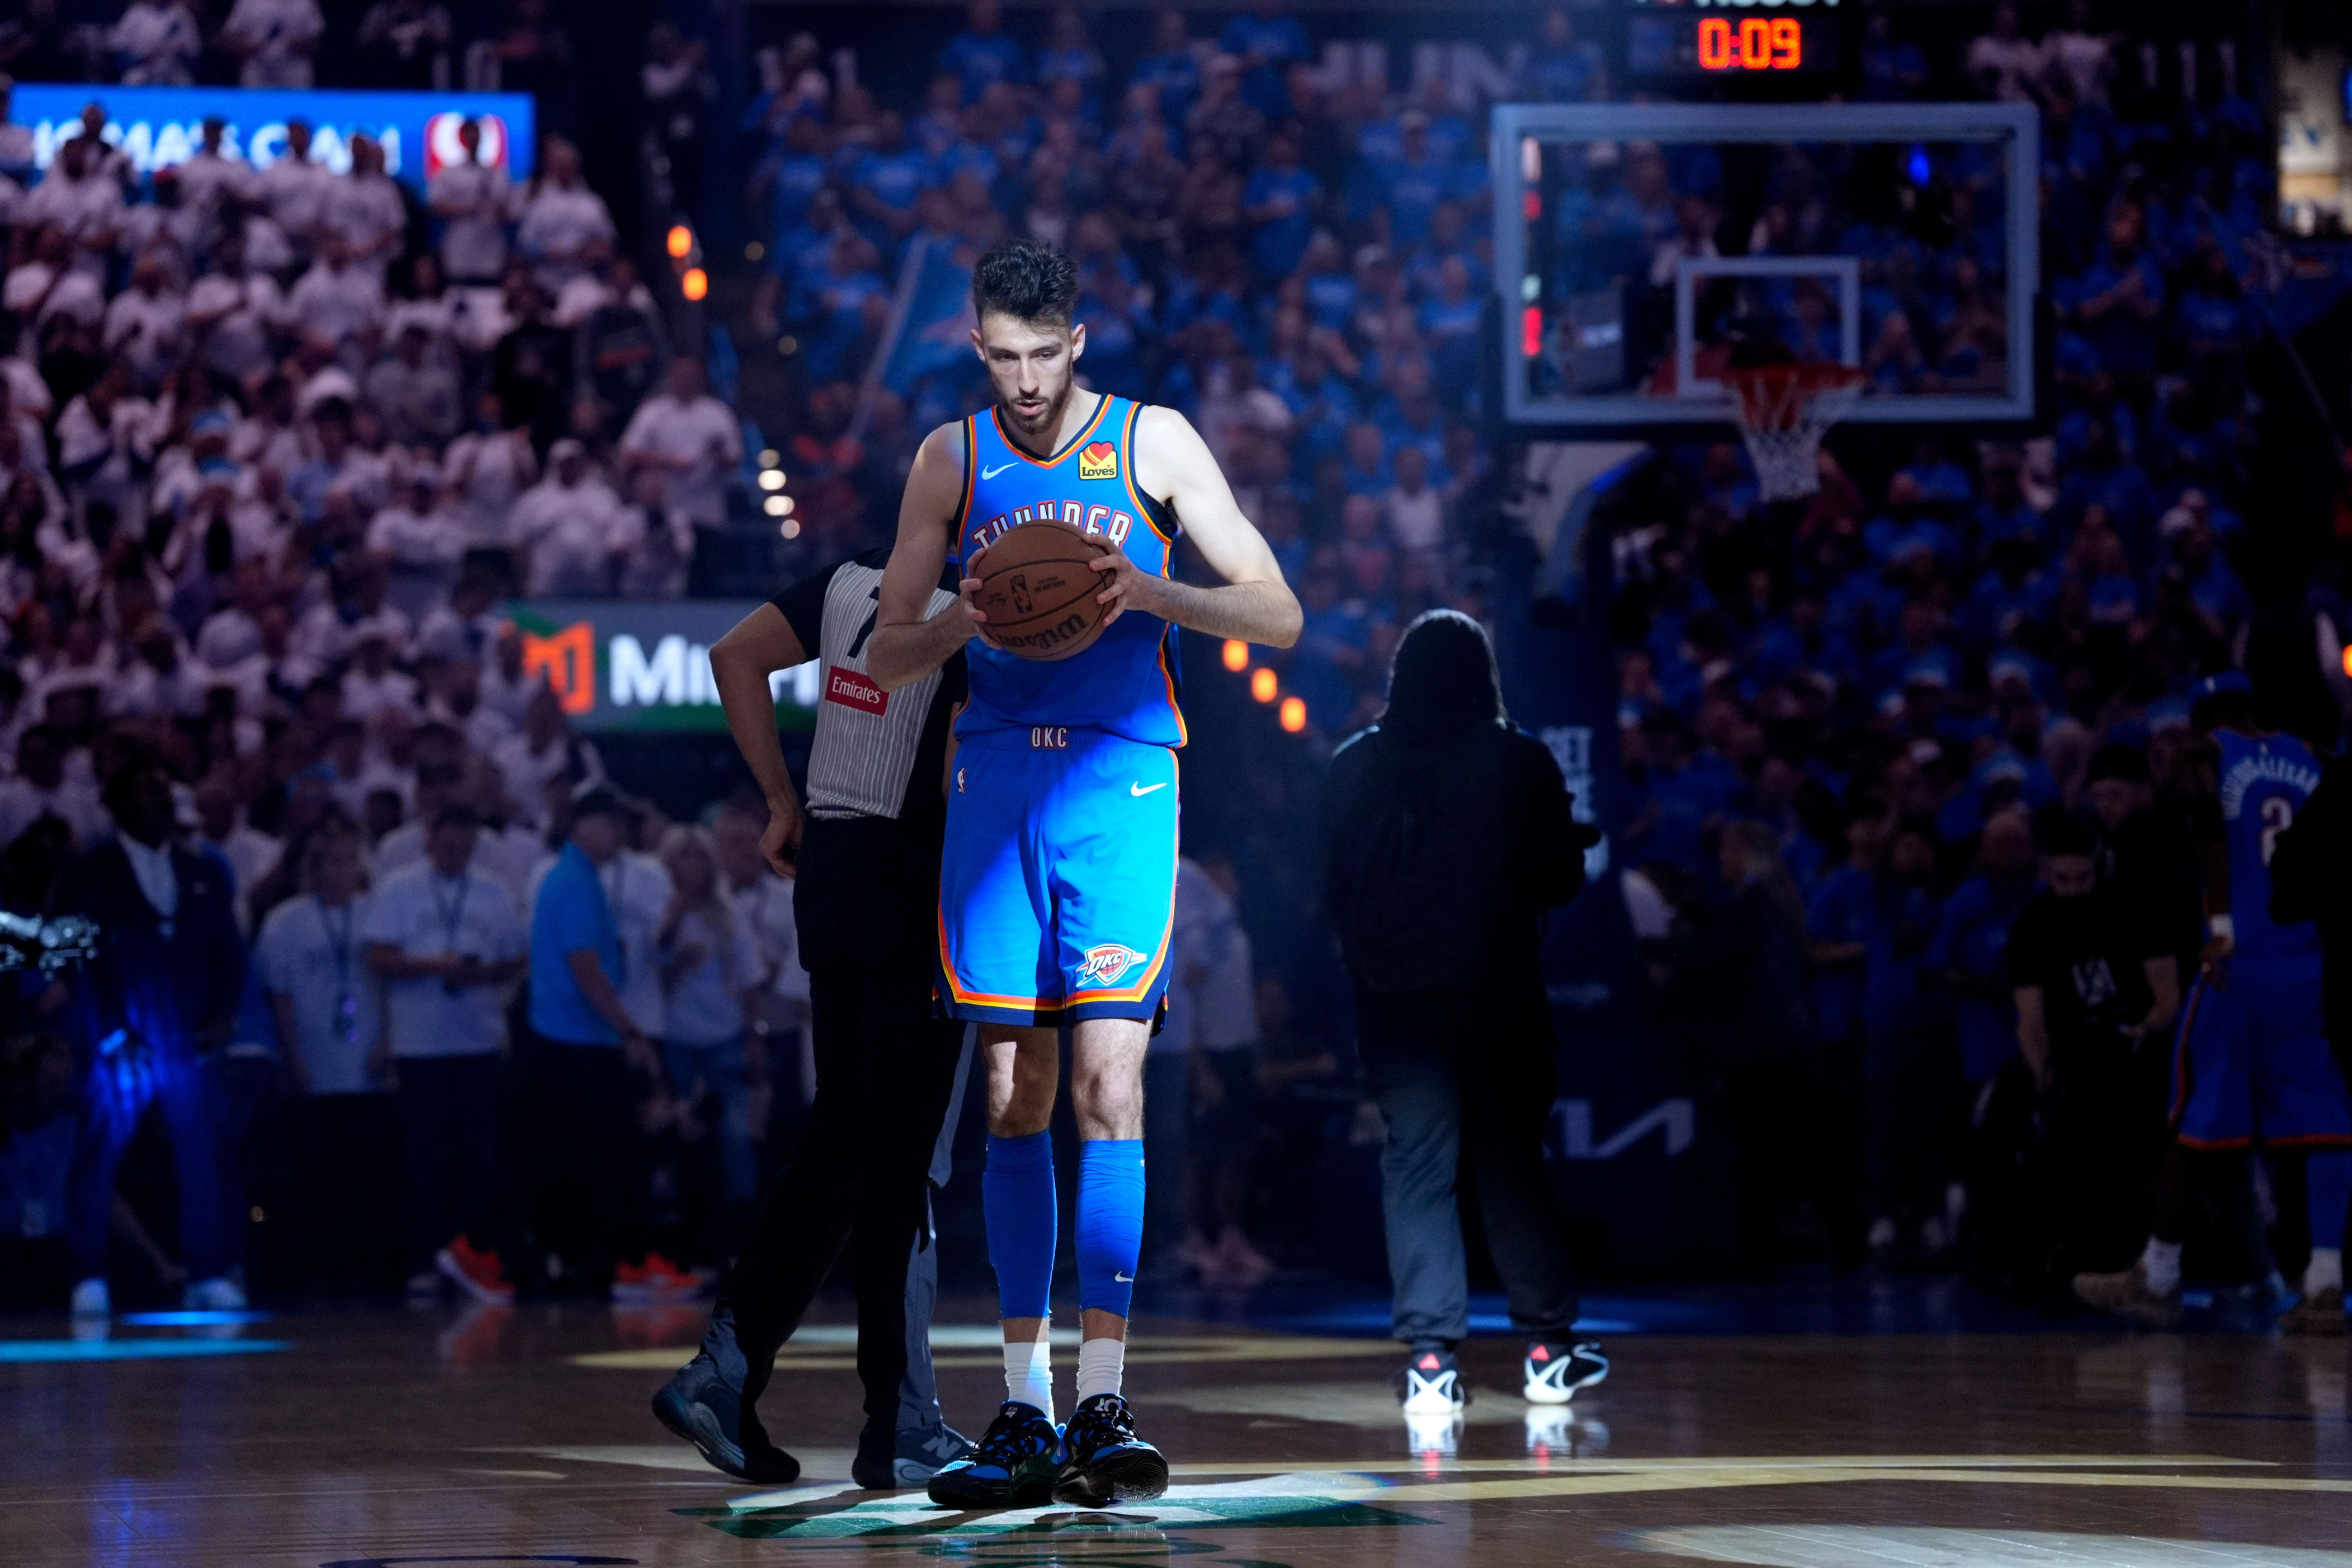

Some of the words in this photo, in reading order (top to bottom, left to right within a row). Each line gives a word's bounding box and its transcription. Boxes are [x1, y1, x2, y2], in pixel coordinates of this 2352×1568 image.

[1699, 18, 1801, 69] 0:09
[832, 676, 881, 704] Emirates
[1031, 726, 1068, 748] OKC
[1085, 952, 1123, 977] OKC
